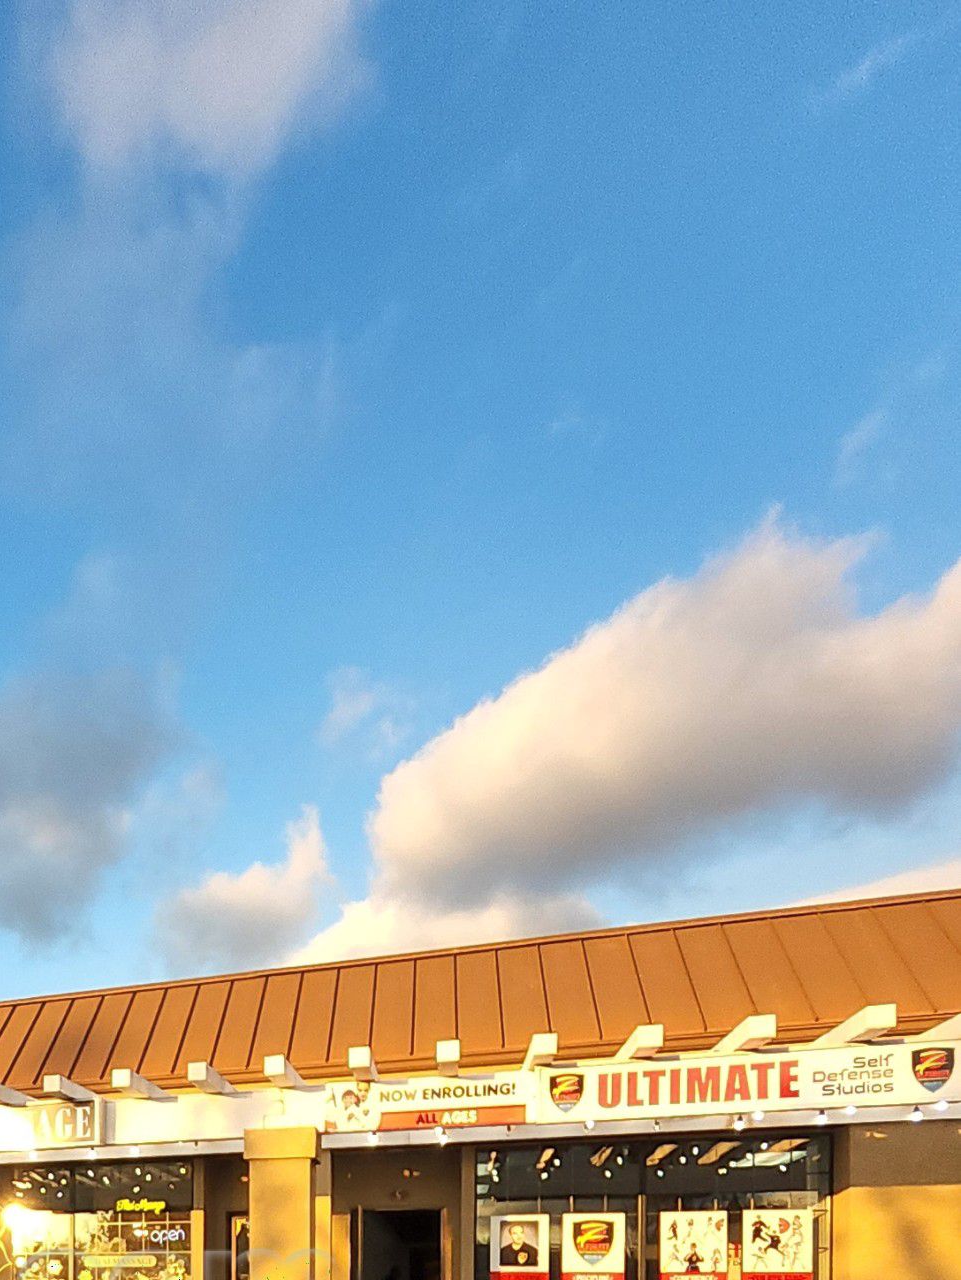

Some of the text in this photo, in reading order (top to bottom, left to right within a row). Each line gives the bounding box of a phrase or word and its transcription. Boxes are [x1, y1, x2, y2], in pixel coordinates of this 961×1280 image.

[853, 1054, 894, 1068] Self
[813, 1068, 894, 1083] Defense
[598, 1060, 800, 1108] ULTIMATE
[822, 1082, 894, 1096] Studios
[380, 1083, 516, 1102] NOW ENROLLING!
[416, 1110, 478, 1125] ALL AGES
[150, 1229, 185, 1244] open
